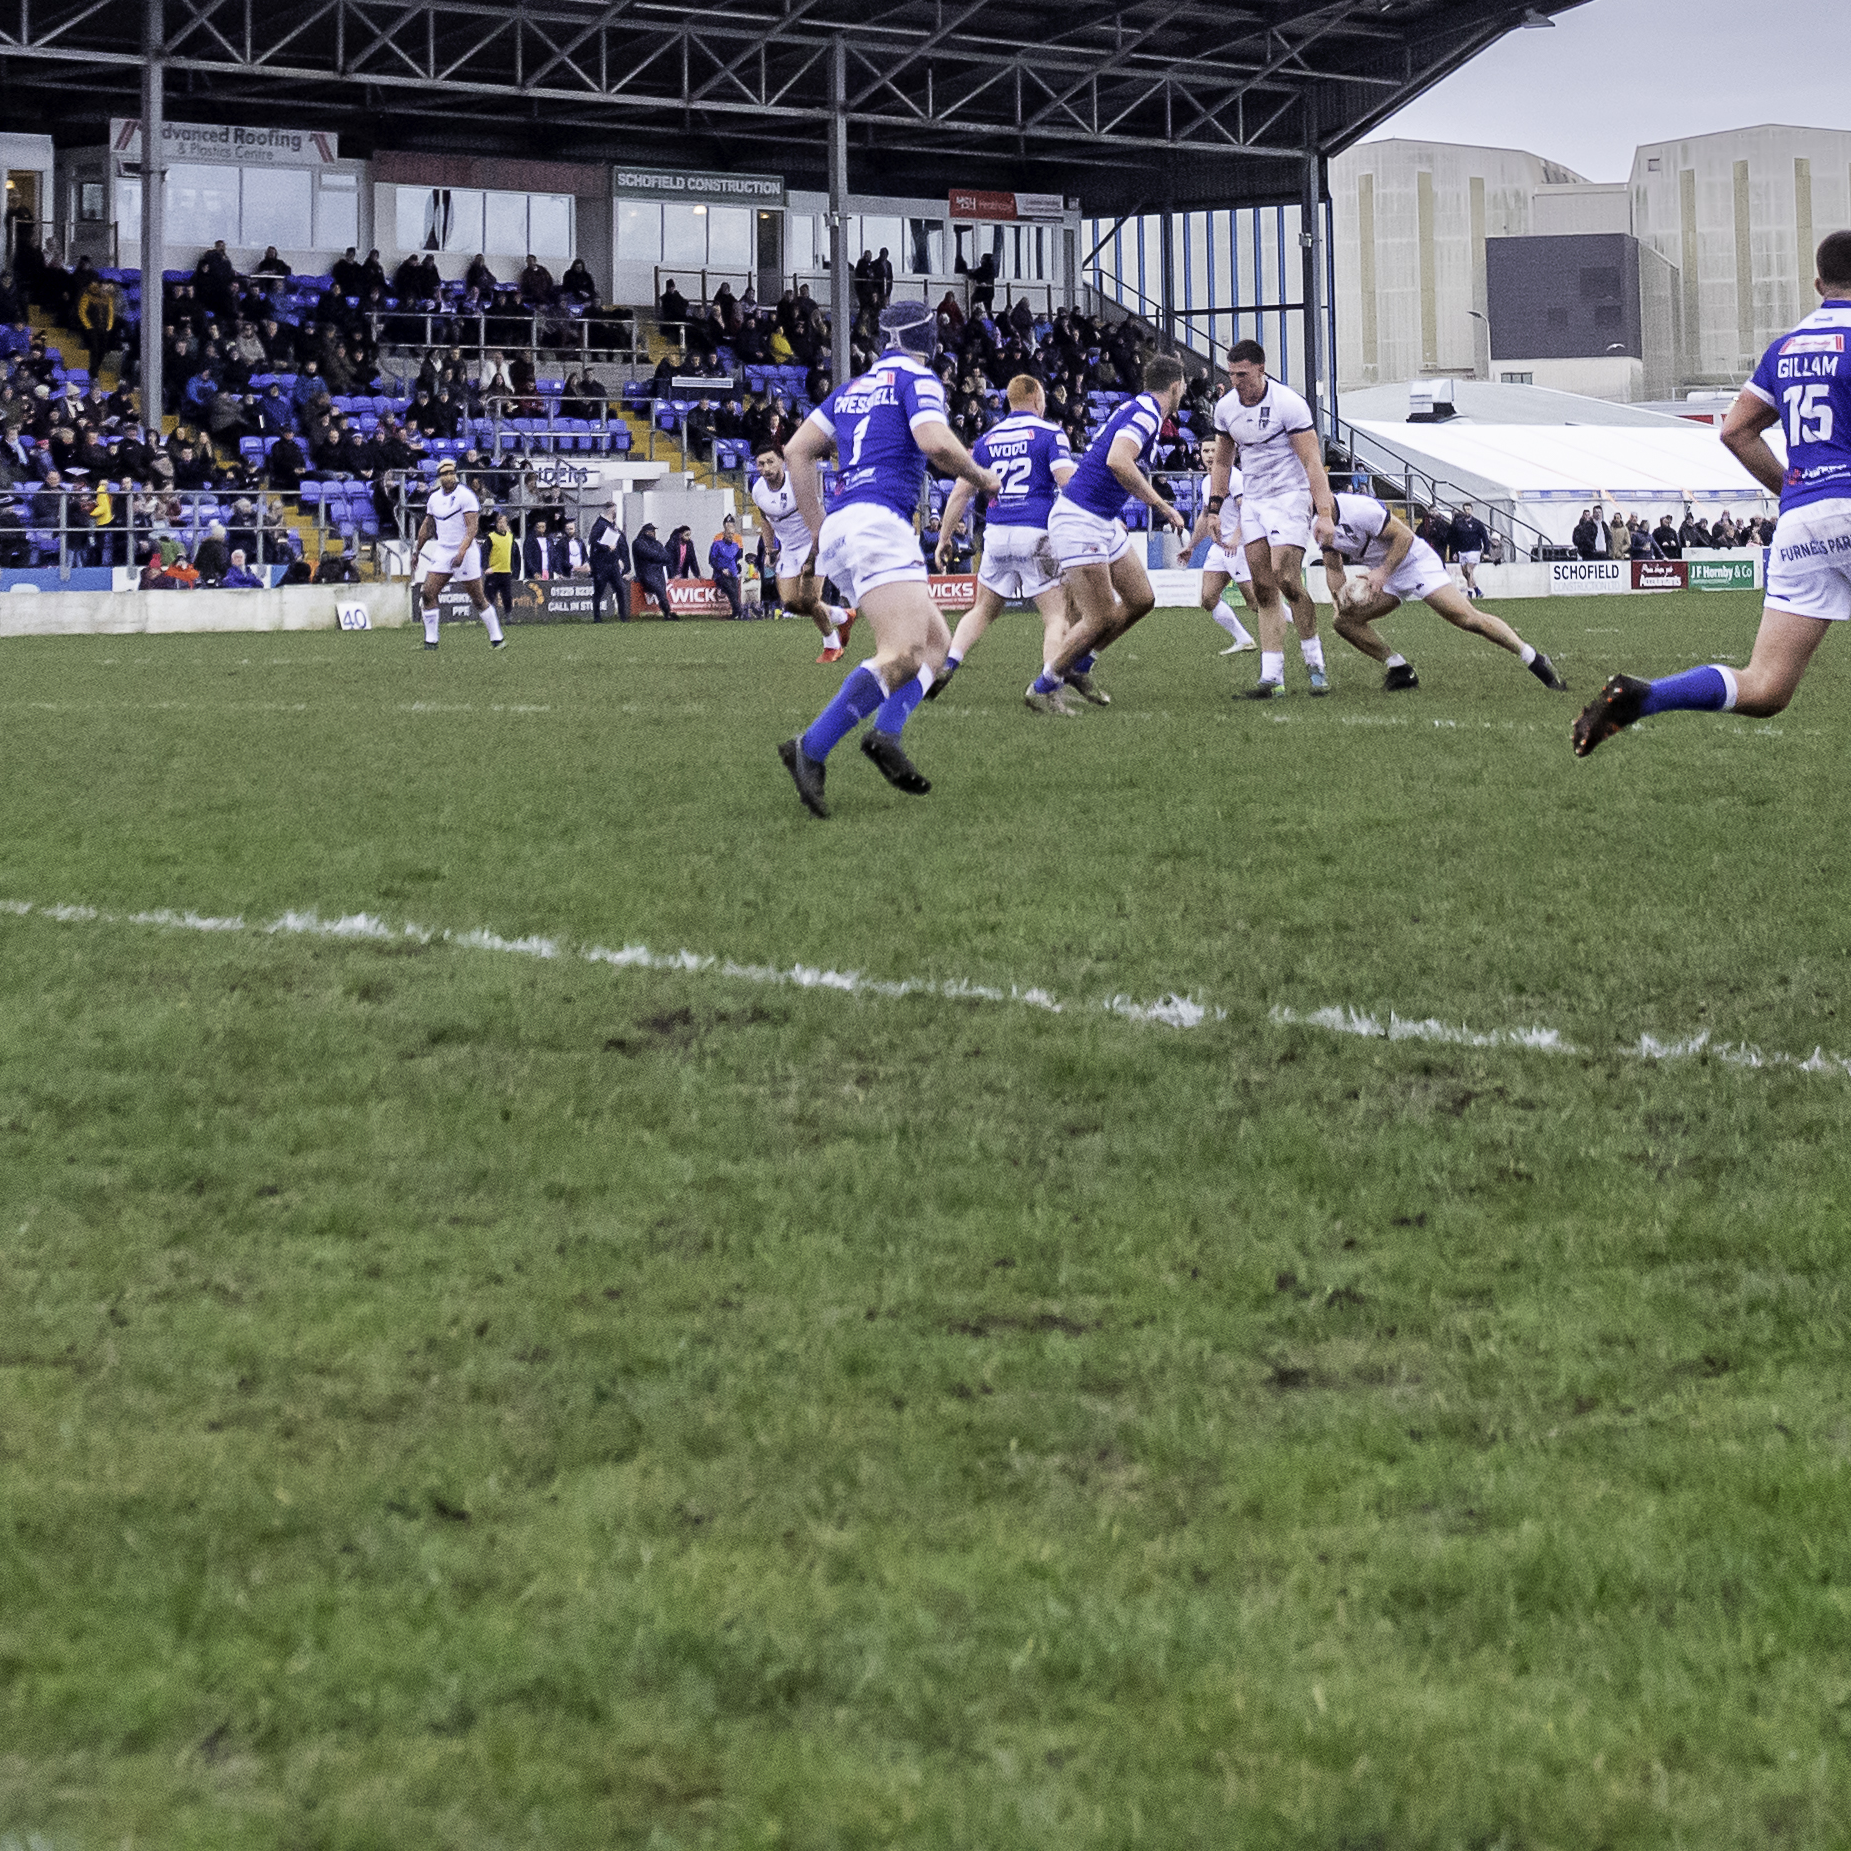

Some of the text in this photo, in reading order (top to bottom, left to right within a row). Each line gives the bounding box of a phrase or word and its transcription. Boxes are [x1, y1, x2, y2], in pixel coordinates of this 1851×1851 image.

[162, 124, 302, 151] dvanced Roofing
[190, 144, 231, 158] Plastics
[235, 146, 274, 160] Centre
[617, 173, 781, 194] SCHOFIELD CONSTRUCTION
[1777, 356, 1838, 378] GILLAM
[1783, 384, 1833, 447] 15
[849, 415, 870, 465] 1
[989, 441, 1027, 457] WOOD
[1553, 564, 1620, 579] SCHOFIELD
[1697, 565, 1702, 578] F
[1703, 565, 1734, 581] Hornby
[1734, 564, 1741, 579] &
[1742, 565, 1752, 578] Co
[1553, 580, 1607, 591] CONSTRUCTION
[548, 601, 568, 612] CALL
[570, 601, 579, 611] IN
[343, 609, 366, 629] 40
